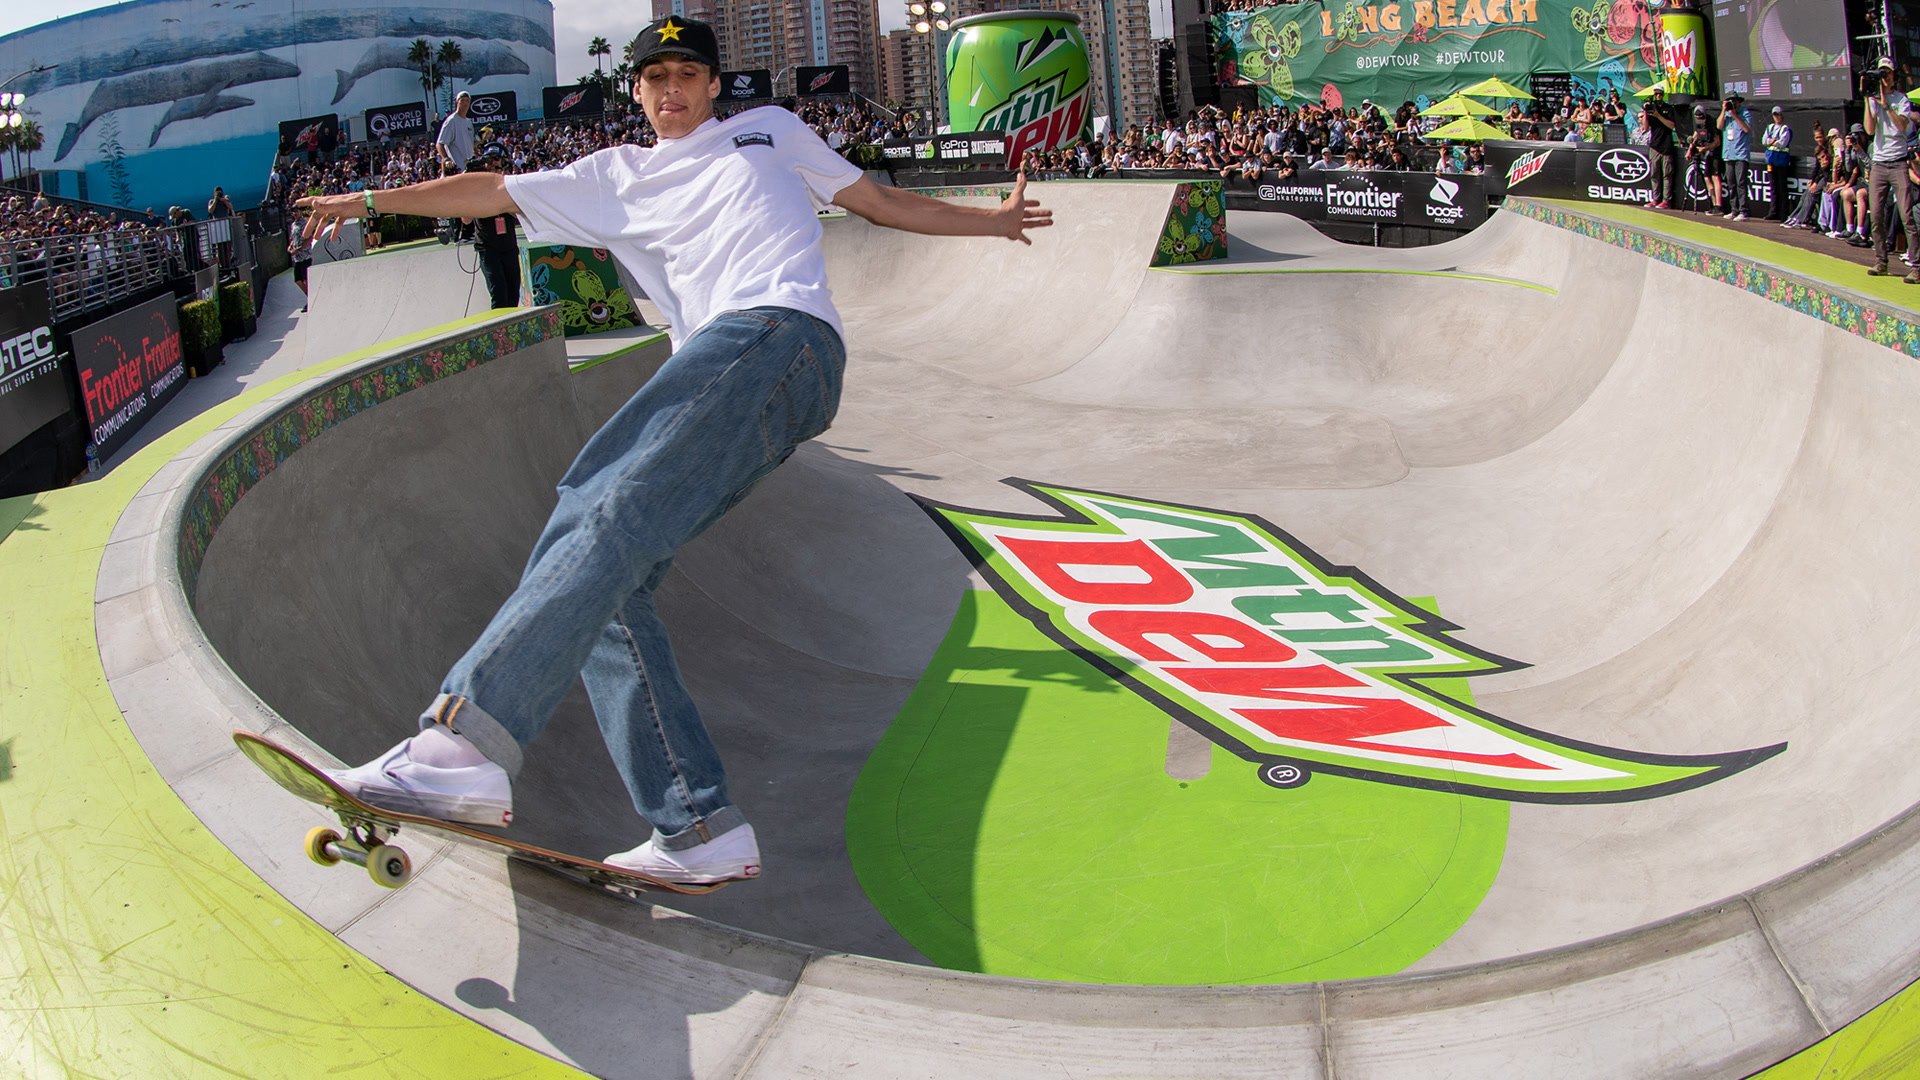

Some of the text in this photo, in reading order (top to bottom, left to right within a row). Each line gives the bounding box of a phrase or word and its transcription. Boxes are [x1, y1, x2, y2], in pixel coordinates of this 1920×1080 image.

[1320, 0, 1538, 37] LNG BEACH
[1356, 50, 1505, 69] @DEWTOUR #DEWTOUR
[731, 88, 755, 96] boost
[389, 110, 422, 121] WORLD
[389, 117, 423, 131] SKATE
[940, 140, 969, 150] GoPro
[1276, 186, 1324, 196] CALIFORNIA
[1276, 195, 1324, 203] skateparks
[1326, 183, 1402, 209] Frontier
[1327, 206, 1397, 218] COMMUNICATIONS
[1426, 204, 1464, 218] boost
[142, 330, 181, 381] Frontier
[14, 371, 35, 388] SINCE
[38, 360, 58, 376] 1973
[150, 361, 185, 400] COMMUNICATIONS
[80, 354, 143, 425] Frontier
[94, 392, 148, 446] COMMUNICATIONS
